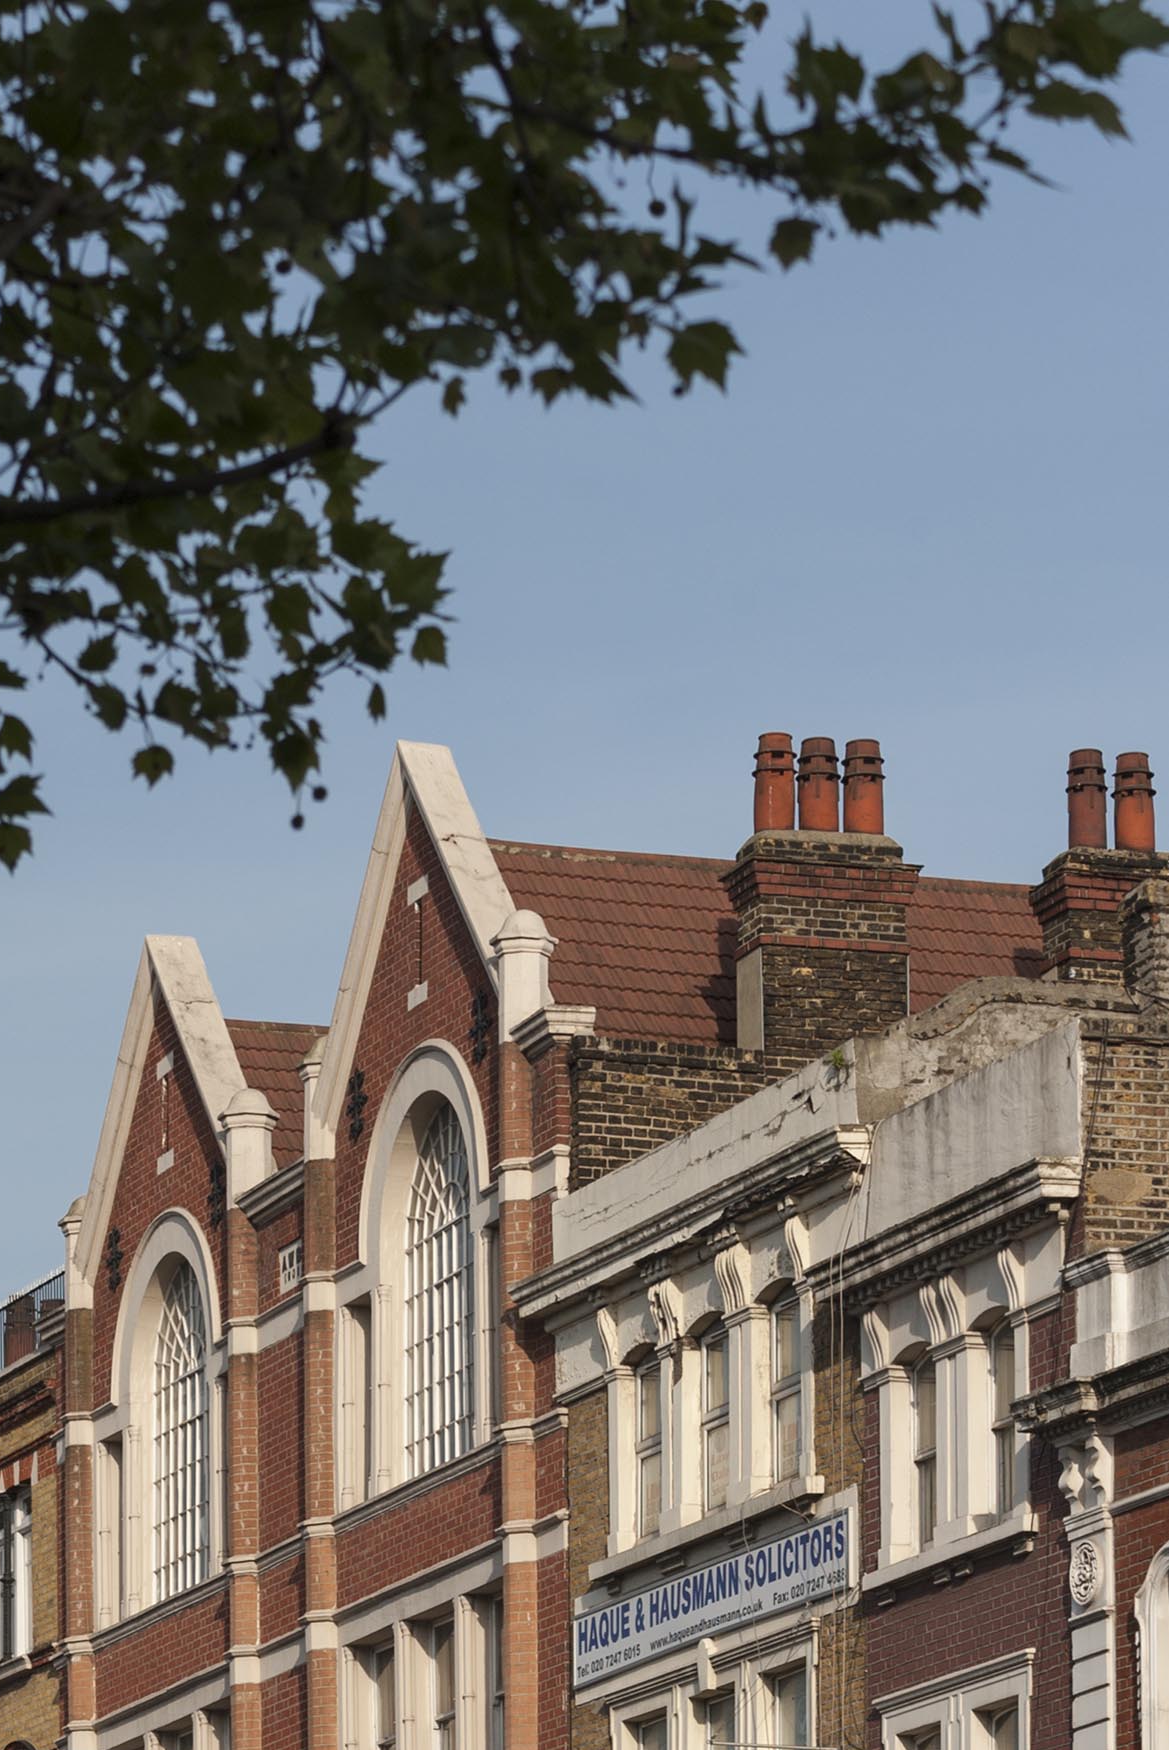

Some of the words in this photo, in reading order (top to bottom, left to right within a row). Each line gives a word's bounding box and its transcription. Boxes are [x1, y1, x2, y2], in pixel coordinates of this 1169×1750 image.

[578, 1602, 631, 1656] HAQUE
[635, 1598, 645, 1633] &
[649, 1559, 739, 1628] HAUSMANN
[744, 1520, 845, 1591] SOLICITORS
[591, 1659, 603, 1674] 020
[606, 1652, 622, 1669] 7247
[623, 1644, 641, 1662] 6015
[650, 1599, 763, 1651] www.haqueandhausmann.co.uk
[773, 1591, 789, 1605] Fax:
[791, 1582, 804, 1599] 020
[806, 1575, 824, 1595] 7247
